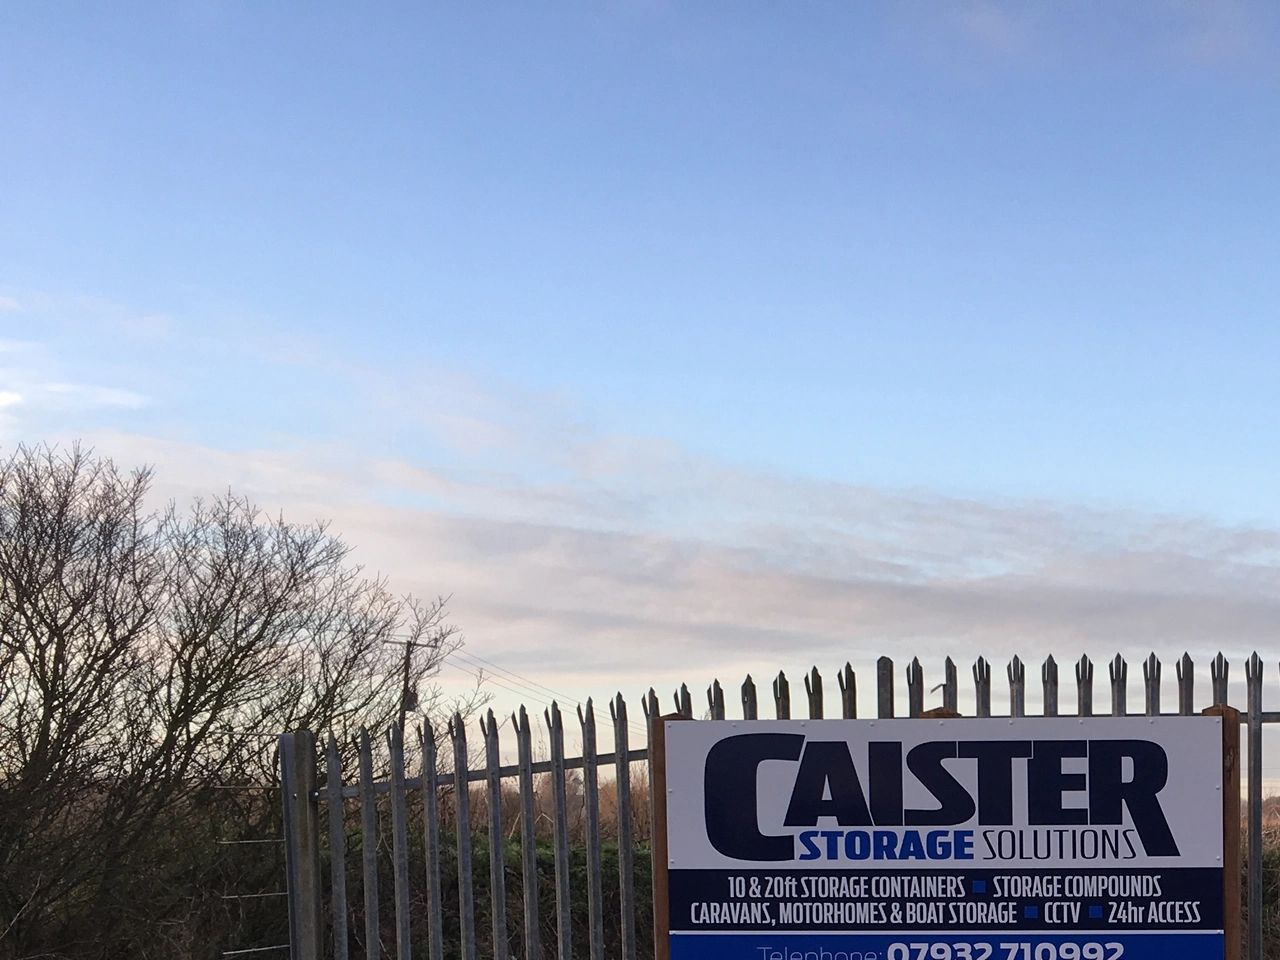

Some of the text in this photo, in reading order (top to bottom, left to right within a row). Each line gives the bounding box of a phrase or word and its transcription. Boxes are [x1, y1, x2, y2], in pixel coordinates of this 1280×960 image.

[704, 732, 1181, 861] CAISTER
[799, 829, 1137, 860] STORAGE SOLUTIONS
[728, 875, 1162, 898] 10 & 20ft STORAGE CONTAINERS STORAGE COMPOUNDS
[690, 901, 1202, 926] CARAVANS, MOTORHOMES & BOAT STORAGE CCTV 24hr ACCESS
